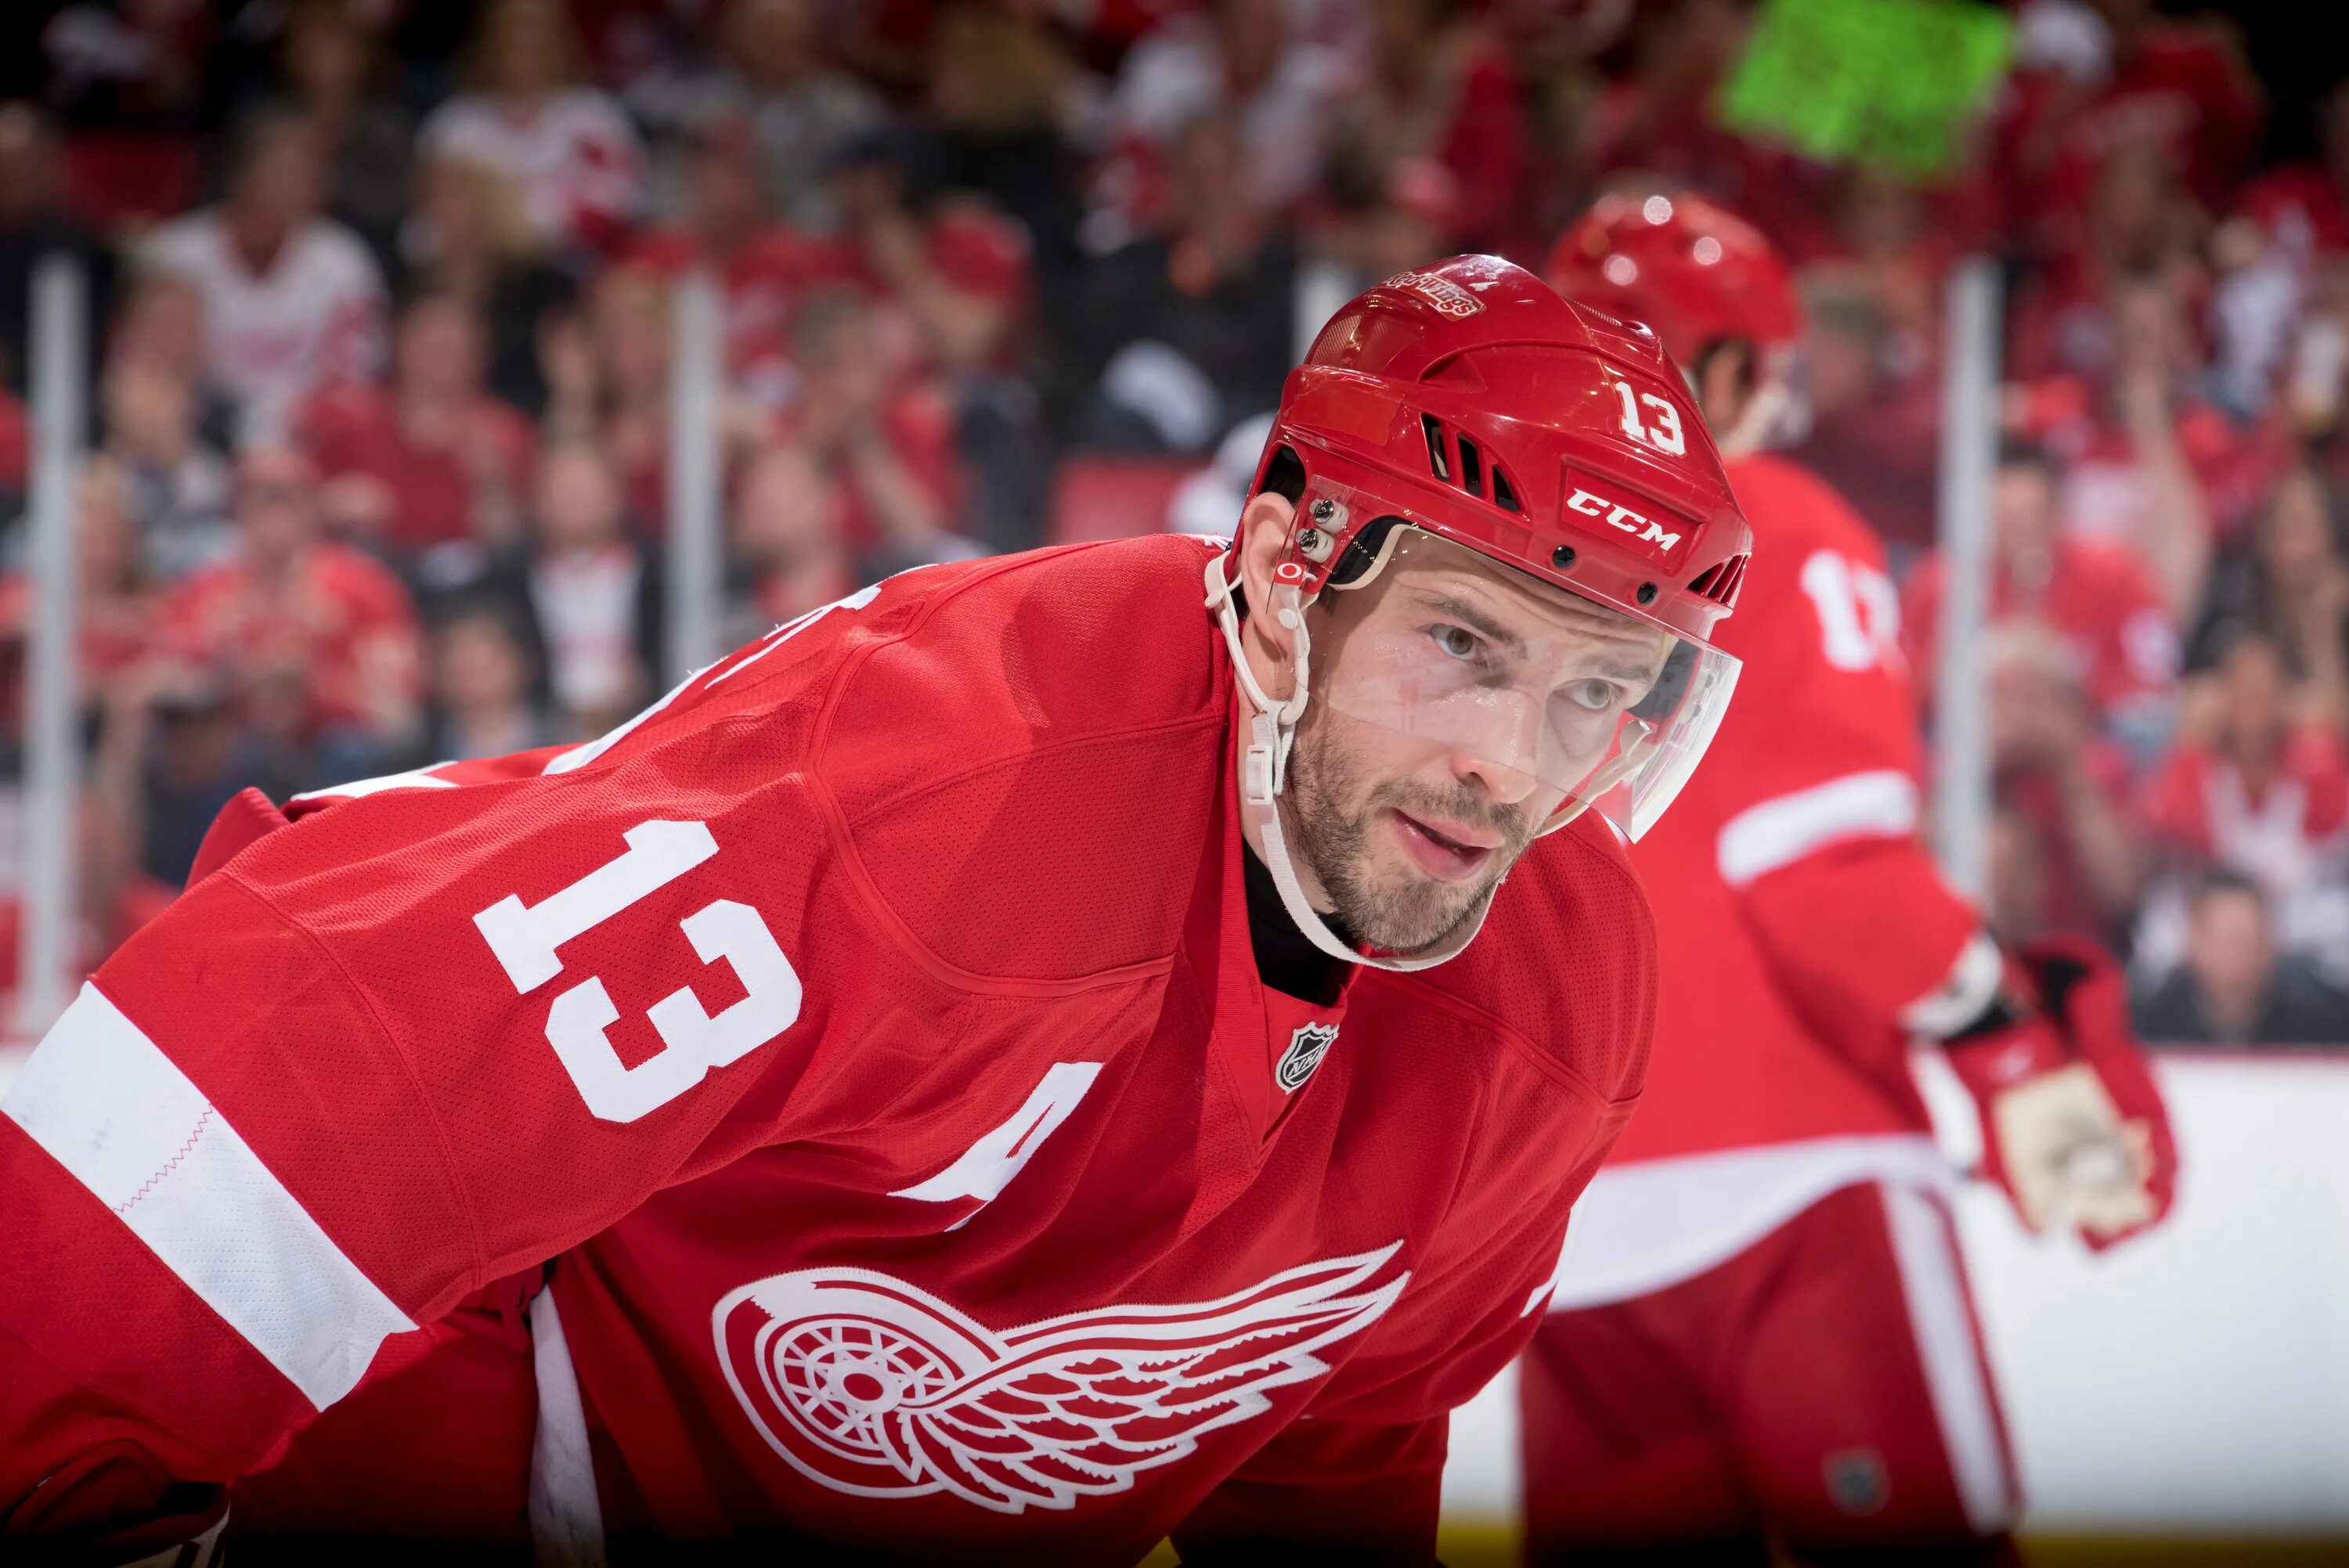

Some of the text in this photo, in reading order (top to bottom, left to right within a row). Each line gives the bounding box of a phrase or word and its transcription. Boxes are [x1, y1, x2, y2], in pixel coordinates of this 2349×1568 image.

[1615, 381, 1686, 456] 13
[1567, 488, 1682, 551] CCM
[472, 819, 803, 1123] 13
